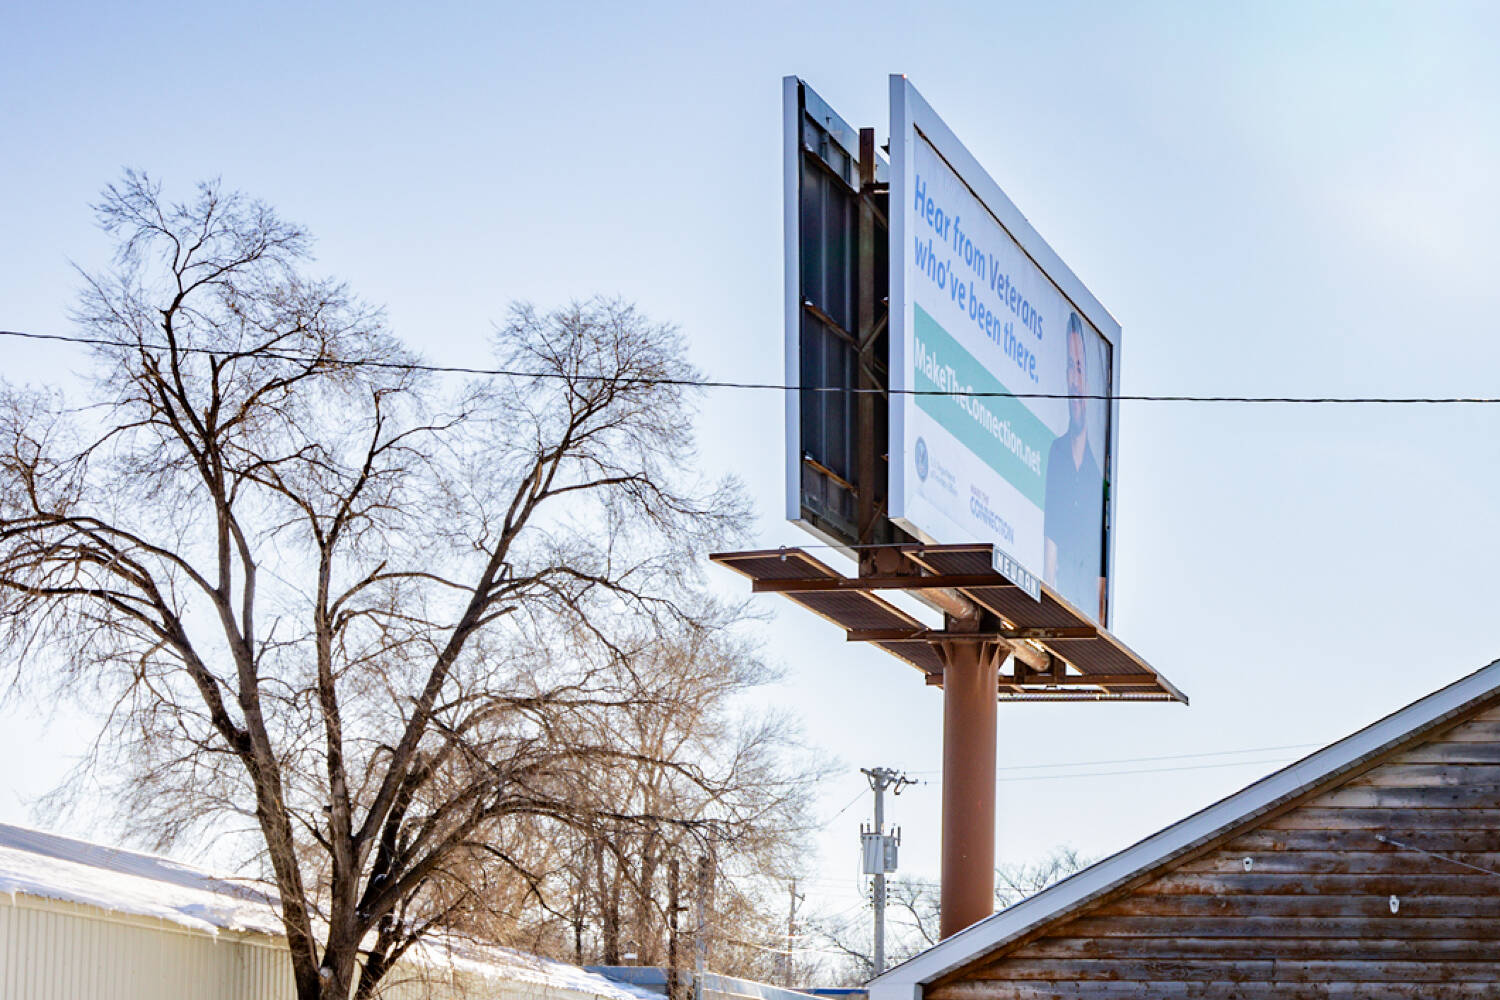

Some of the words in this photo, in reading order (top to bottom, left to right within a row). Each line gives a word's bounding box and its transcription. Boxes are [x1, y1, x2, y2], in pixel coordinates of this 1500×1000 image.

[914, 174, 950, 242] Hear
[953, 215, 986, 281] from
[990, 253, 1043, 341] Veterans
[914, 236, 966, 311] who've
[969, 281, 1000, 346] been
[1003, 322, 1039, 384] there.
[914, 337, 1041, 477] MakeTheConnection.net
